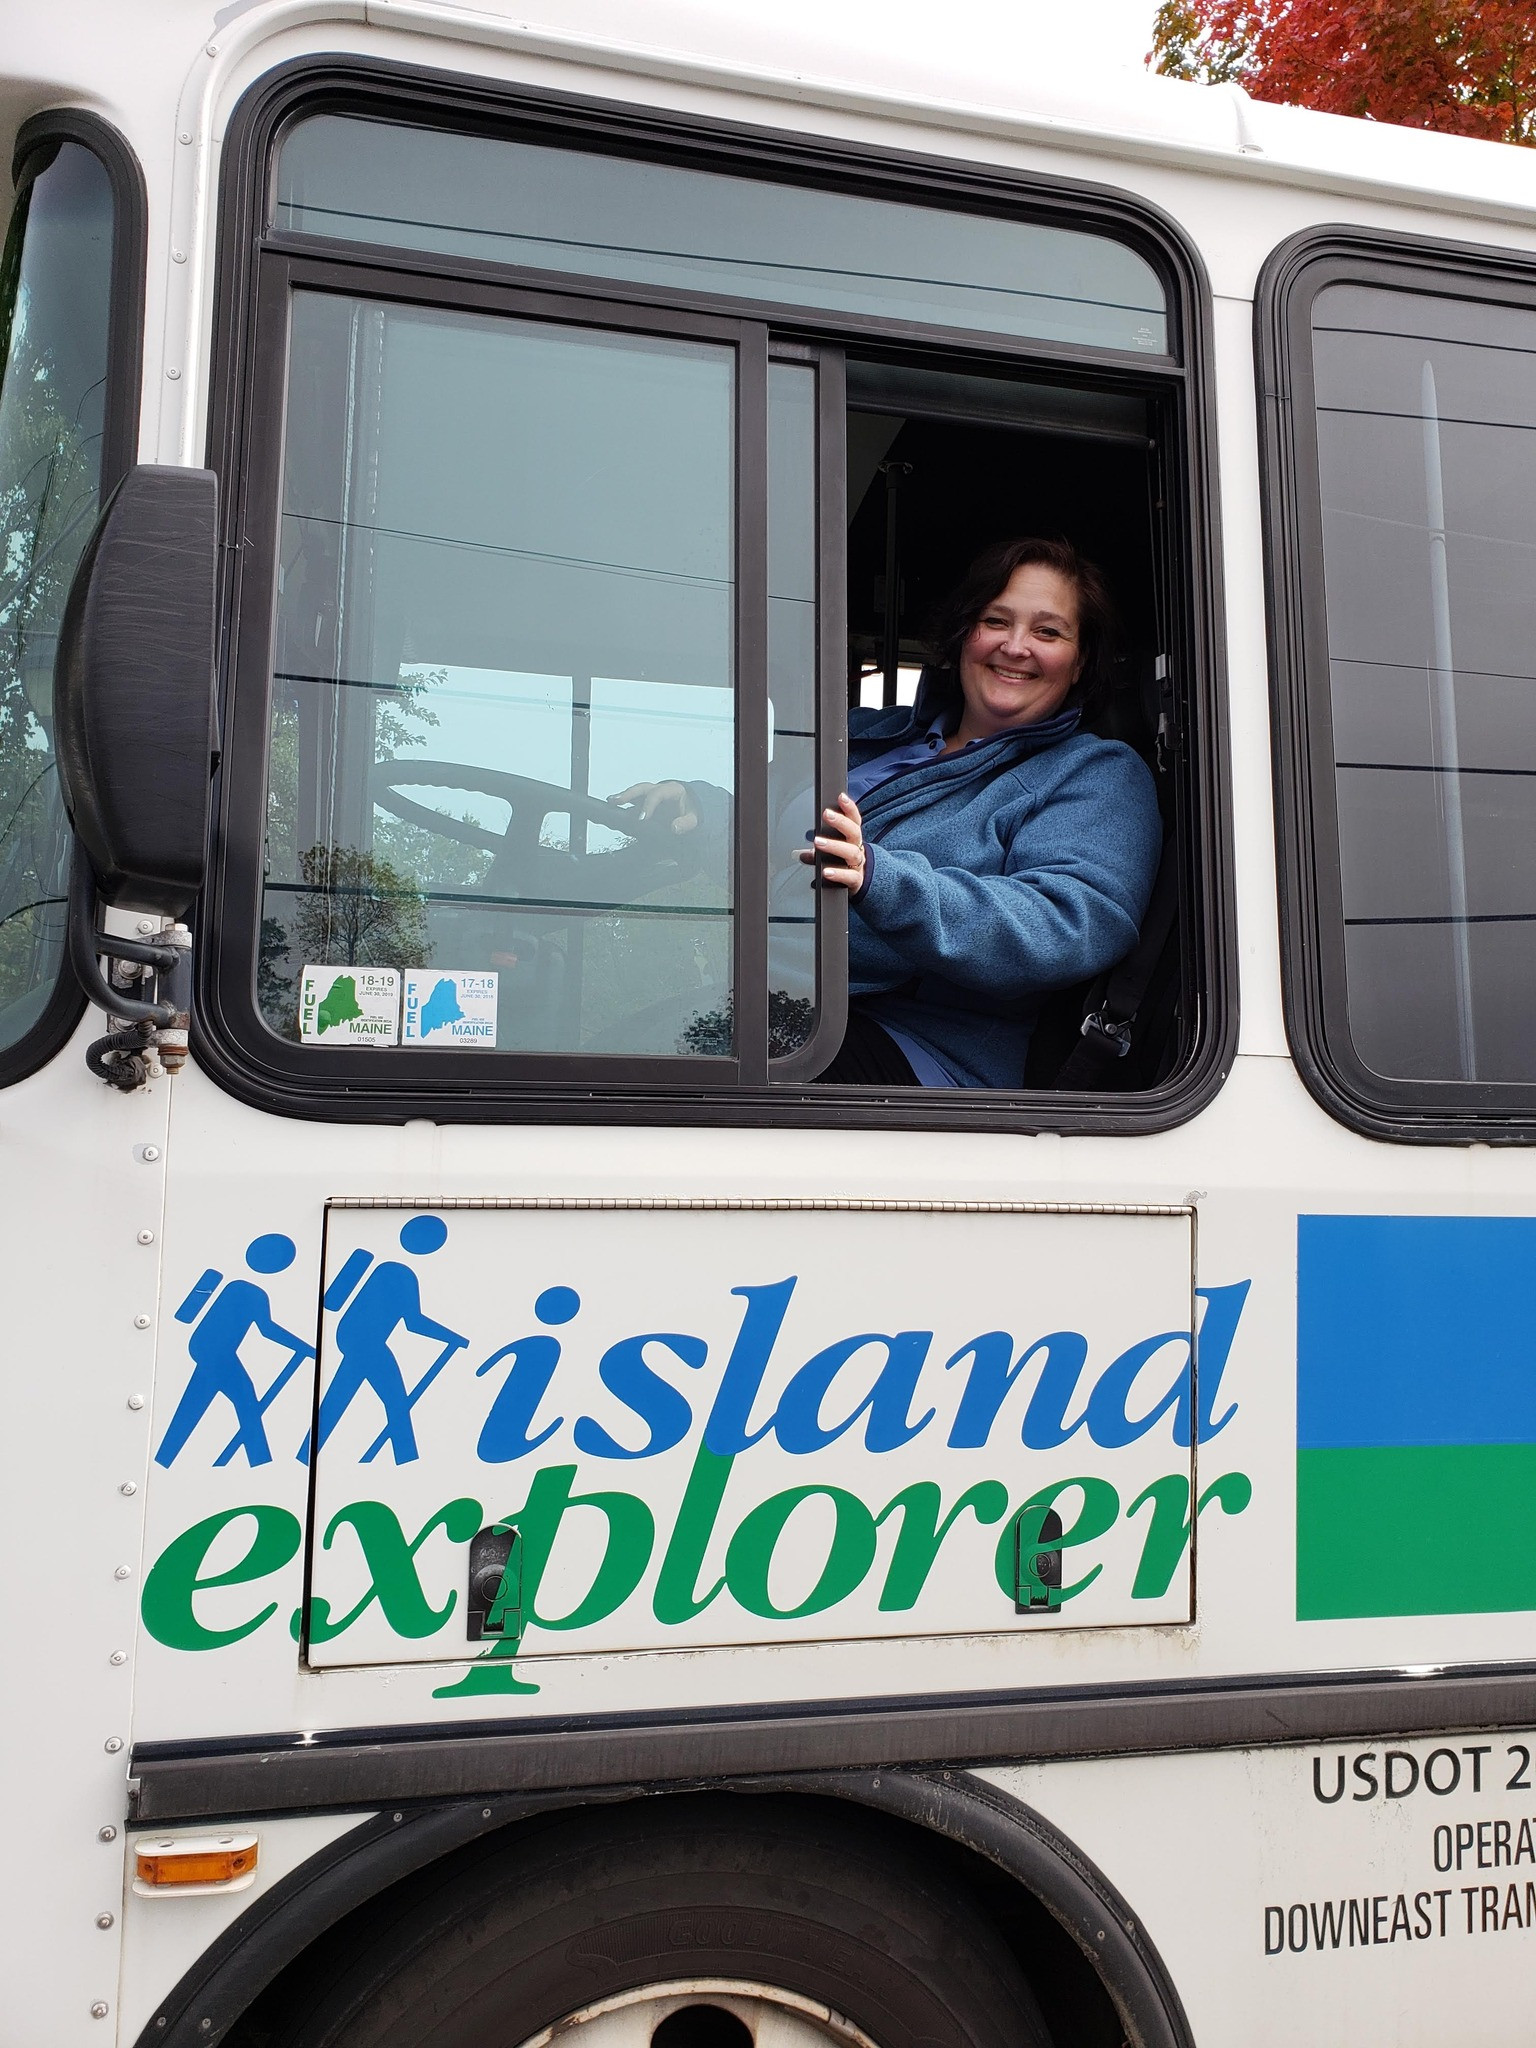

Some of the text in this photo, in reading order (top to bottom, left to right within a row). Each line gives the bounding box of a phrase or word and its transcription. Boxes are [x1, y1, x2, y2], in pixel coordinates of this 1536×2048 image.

[302, 979, 316, 1034] FUEL
[360, 975, 394, 986] 18-19
[461, 978, 494, 988] 17-18
[350, 1022, 393, 1035] MAINE
[406, 983, 419, 1038] FUEL
[452, 1025, 494, 1036] MAINE
[475, 1275, 1252, 1464] island
[140, 1442, 1253, 1699] explorer
[1312, 1744, 1536, 1804] USDOT 2
[1433, 1817, 1536, 1873] OPERA
[1264, 1888, 1452, 1956] DOWNEAST
